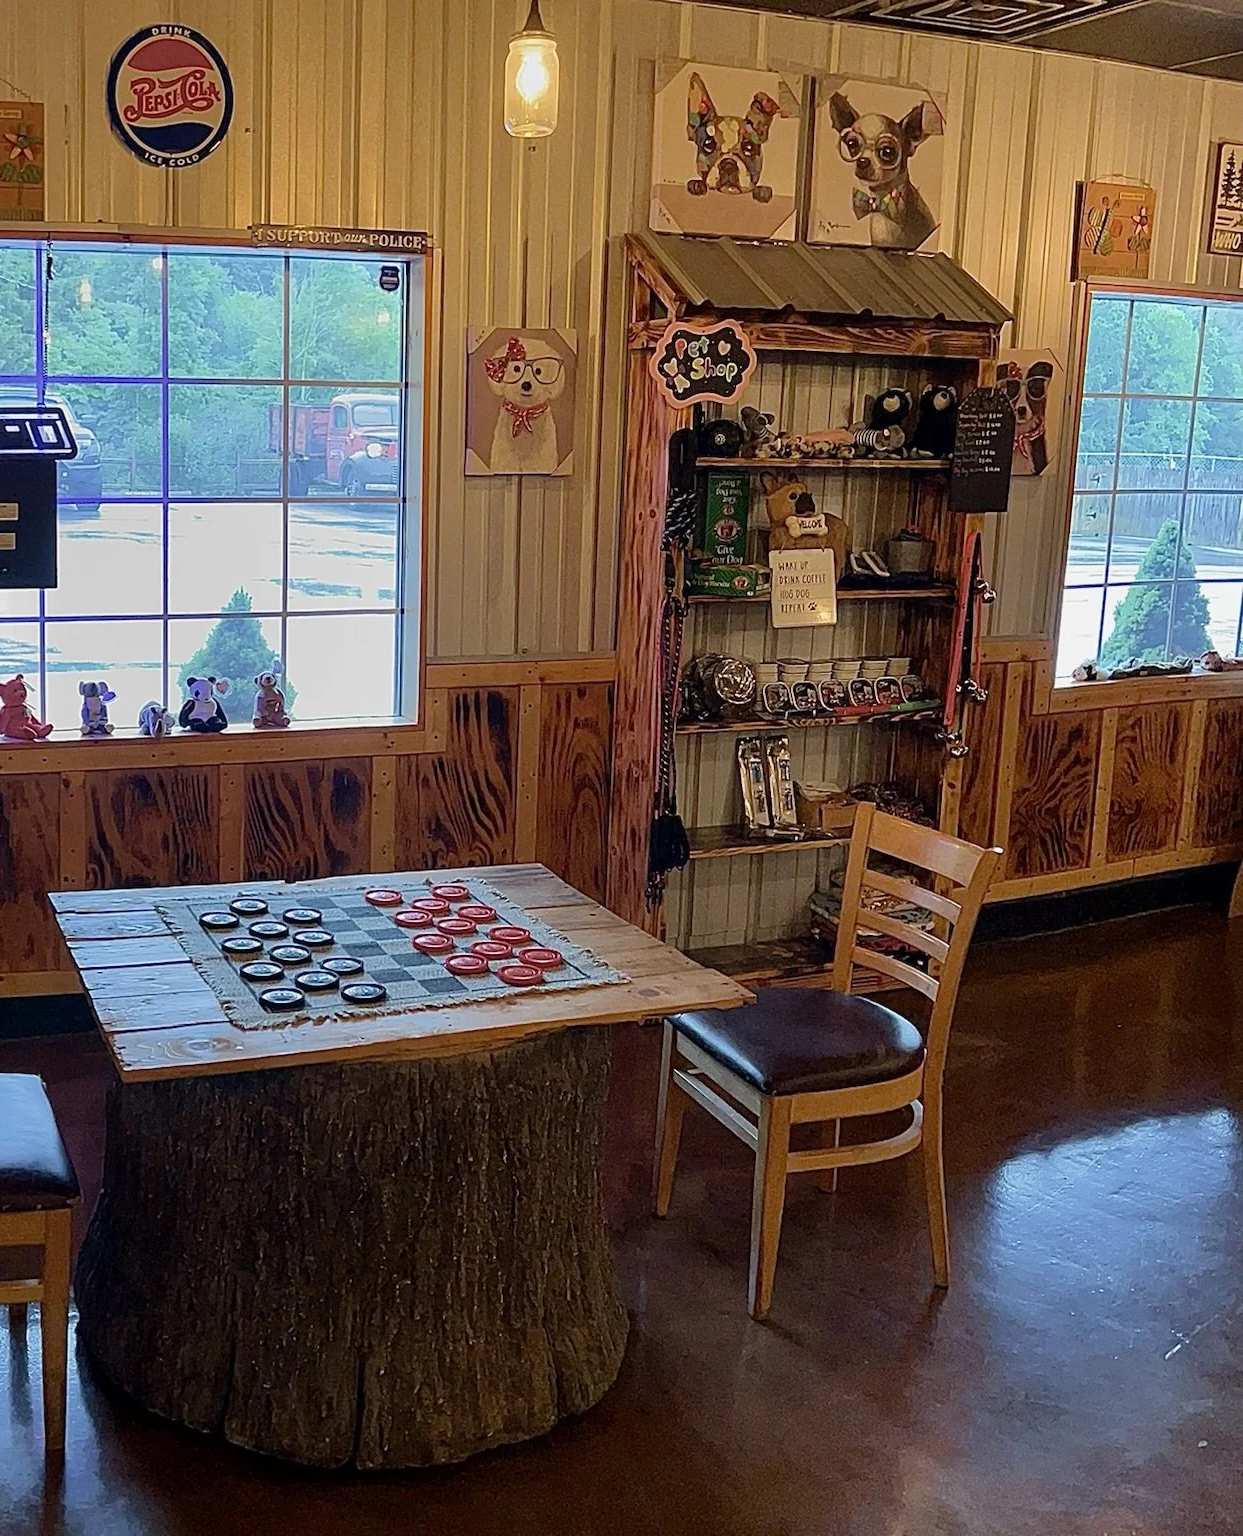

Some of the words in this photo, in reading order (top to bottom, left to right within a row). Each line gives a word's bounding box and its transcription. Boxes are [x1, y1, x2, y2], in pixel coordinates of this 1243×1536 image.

[151, 27, 191, 38] DRINK
[144, 152, 162, 164] ICE
[168, 154, 200, 166] COLD
[266, 228, 341, 245] SUPPORT
[369, 234, 423, 249] POLICE
[675, 336, 710, 360] Pet
[690, 356, 738, 383] Shop
[778, 562, 798, 571] WAKE
[779, 575, 800, 585] DRINK
[802, 574, 826, 584] COFFEE
[780, 589, 794, 599] HUG
[795, 589, 810, 599] DOG
[780, 602, 805, 613] REPEAT
